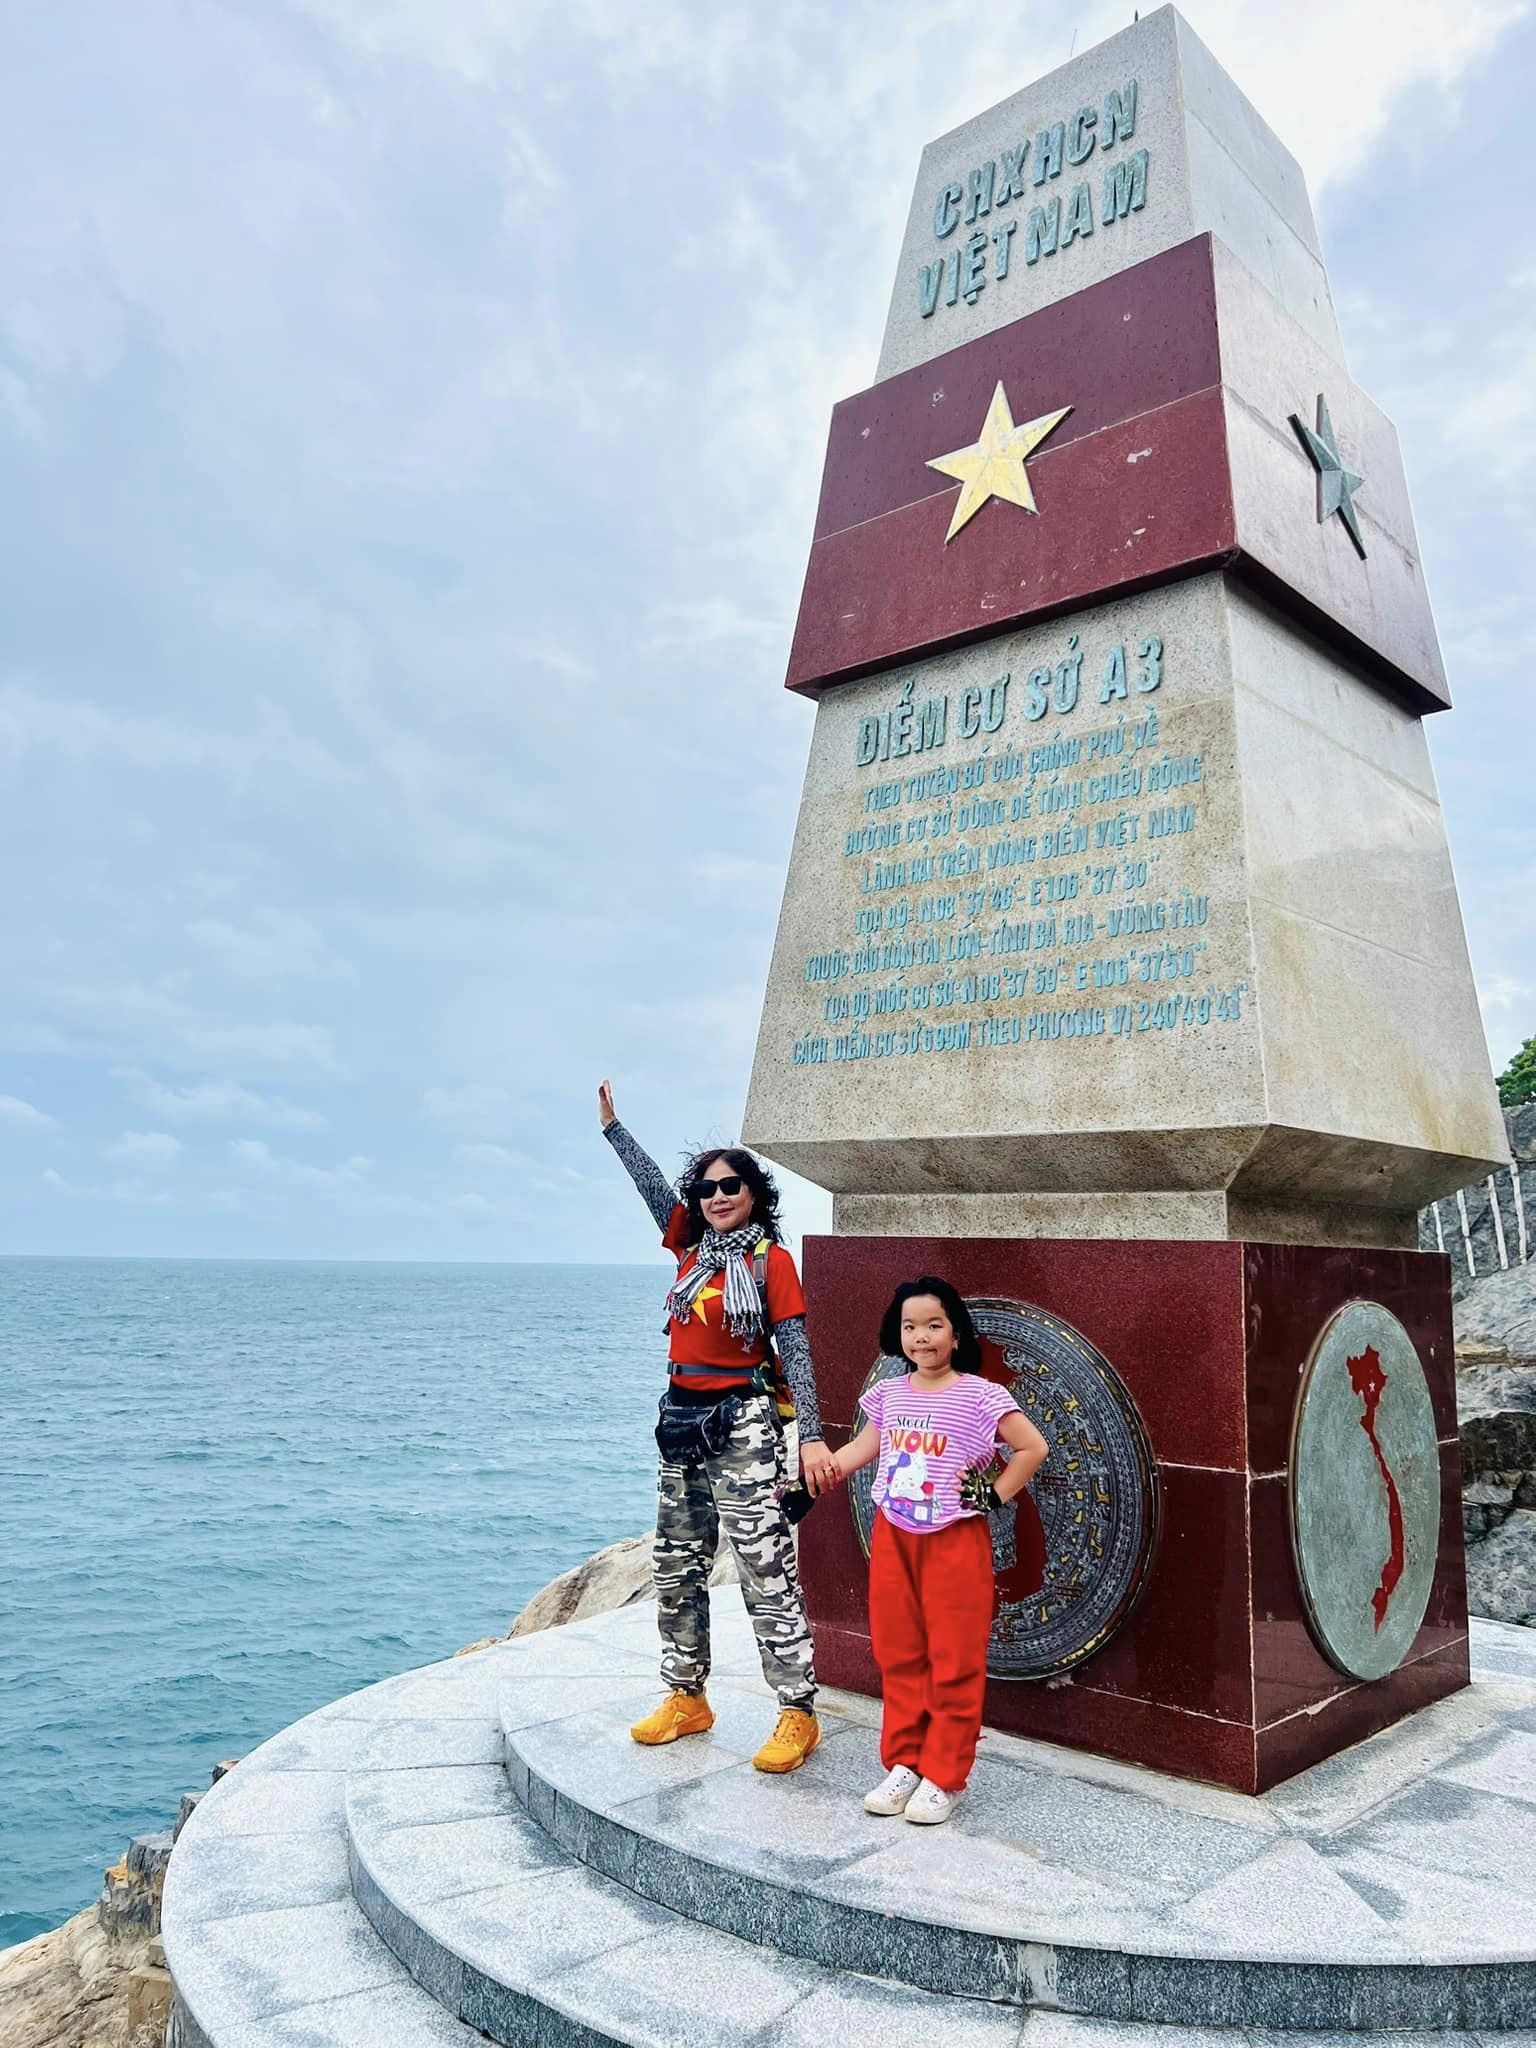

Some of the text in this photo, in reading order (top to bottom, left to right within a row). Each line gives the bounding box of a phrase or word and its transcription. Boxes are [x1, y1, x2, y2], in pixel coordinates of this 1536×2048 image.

[934, 78, 1138, 239] CHXHCN
[917, 148, 1150, 319] VIỆT NAM
[856, 678, 947, 767] ĐIỂM
[959, 671, 1010, 739] CƠ
[1023, 632, 1084, 721] SỞ
[844, 751, 1203, 857] ĐƯỜNG CƠ SỞ DÙNG ĐỂ TÍNH CHIỀU RỘNG
[863, 704, 1160, 813] THEO TUYÊN BỐ CỦA CHÍNH PHỦ VỀ
[909, 843, 934, 884] HẢI
[939, 843, 981, 879] TRÊN
[987, 829, 1036, 870] VÙNG
[1041, 811, 1089, 860] BIỂN
[1095, 809, 1140, 850] VIỆT
[1147, 803, 1196, 839] NAM
[804, 947, 850, 986] THUỘC
[853, 932, 880, 975] ĐẢO
[1034, 907, 1056, 950] BÀ
[1170, 888, 1209, 929] TÀU
[792, 1028, 828, 1066] CÁCH
[832, 1018, 871, 1061] ĐIỂM
[977, 1015, 1021, 1047] THEO
[1025, 1007, 1105, 1042] PHƯƠNG
[1111, 1003, 1133, 1040] VỊ
[874, 975, 908, 1015] MỐC
[911, 983, 934, 1010] CƠ
[888, 1429, 948, 1458] WOW
